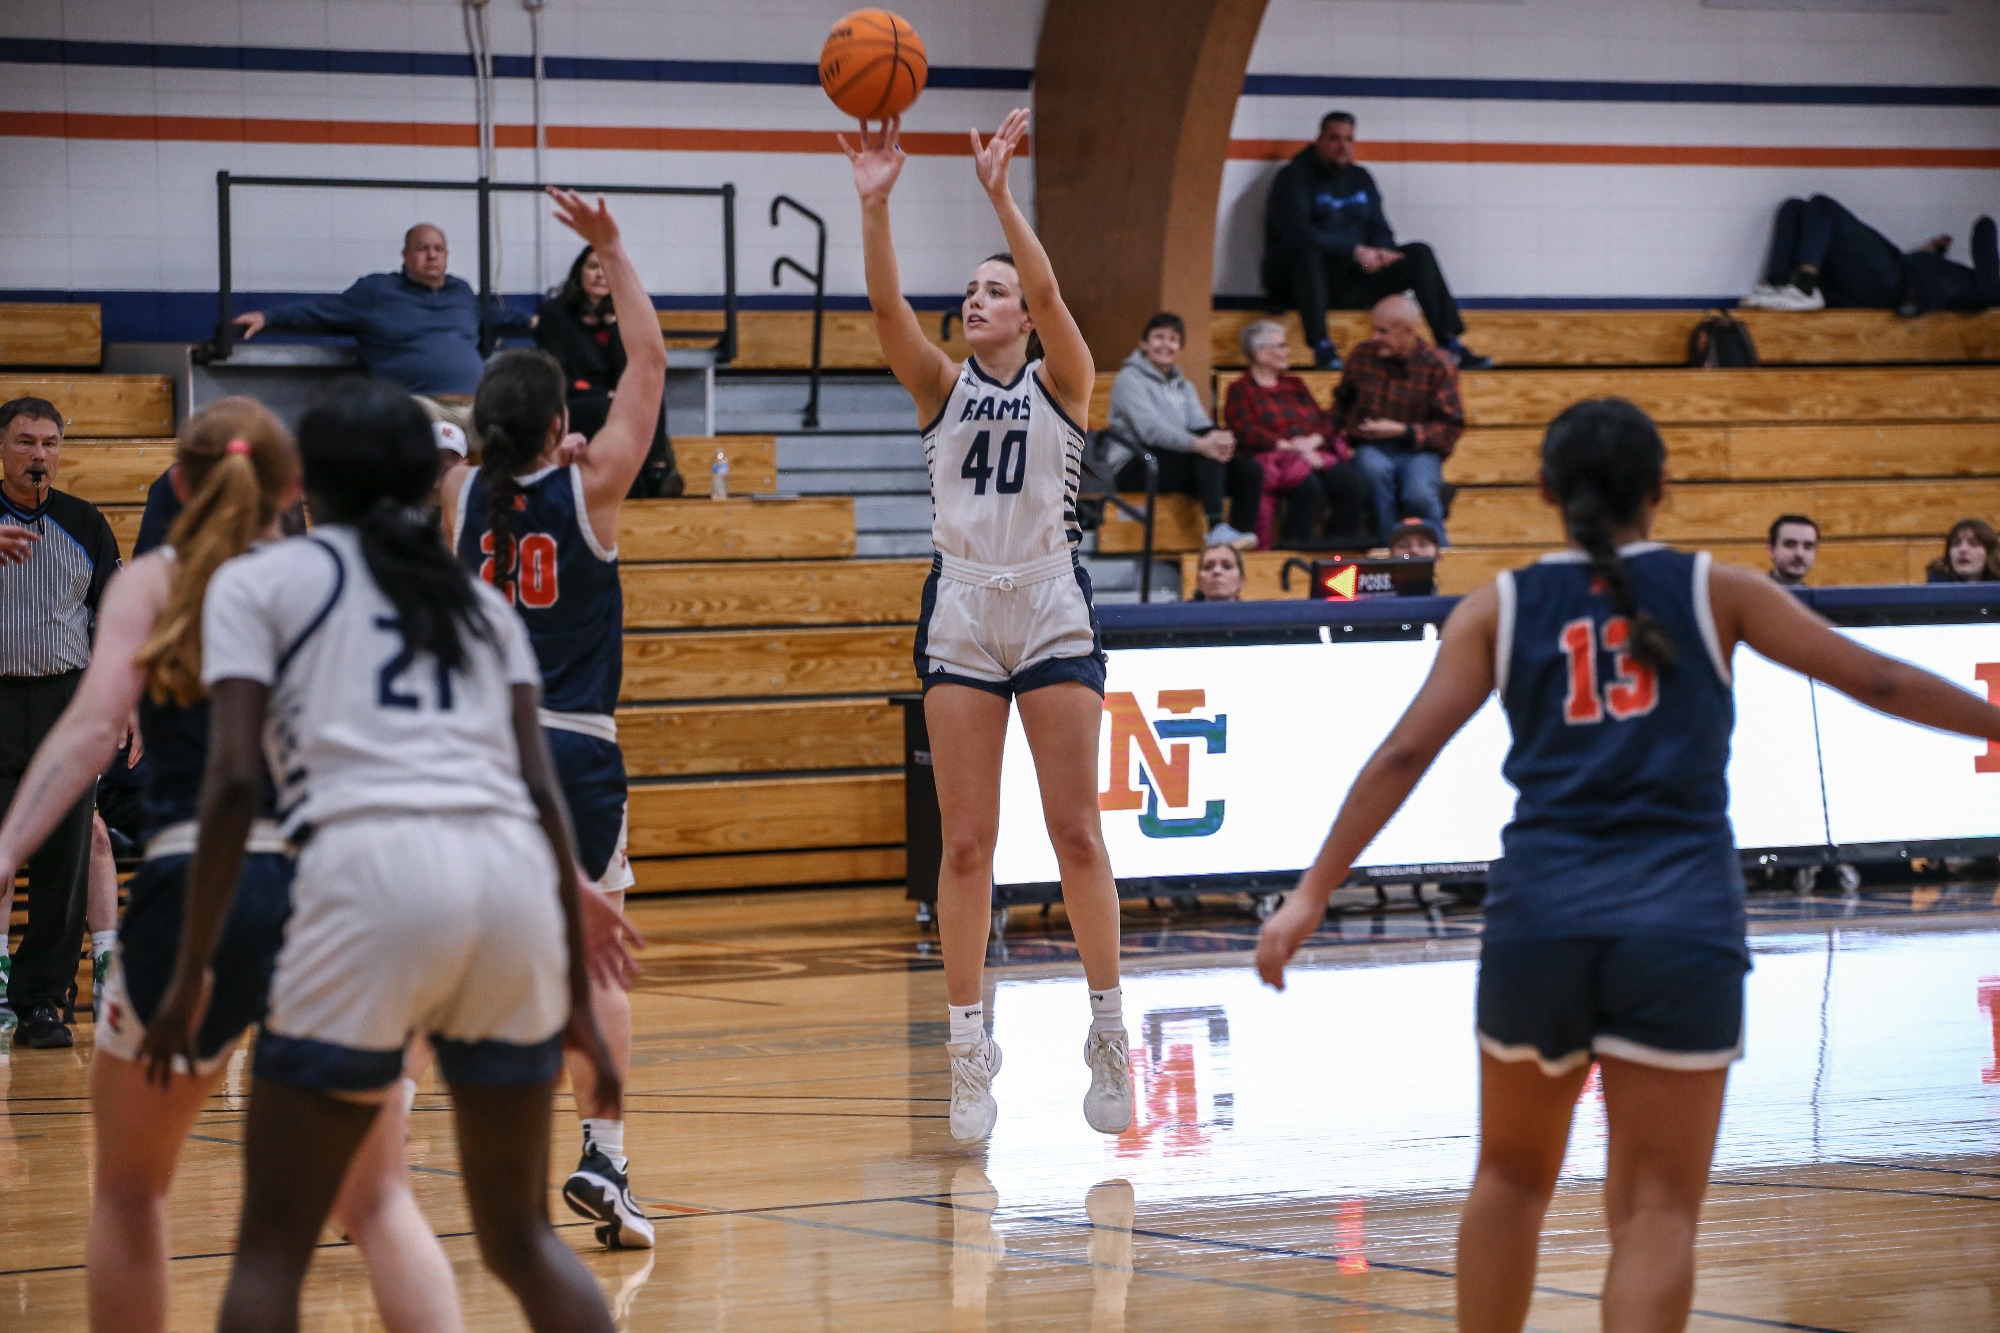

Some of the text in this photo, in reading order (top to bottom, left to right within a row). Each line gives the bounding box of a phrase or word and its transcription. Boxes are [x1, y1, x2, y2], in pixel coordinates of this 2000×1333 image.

[960, 395, 1031, 422] RAMS
[961, 430, 1027, 495] 40
[1558, 616, 1660, 726] 13
